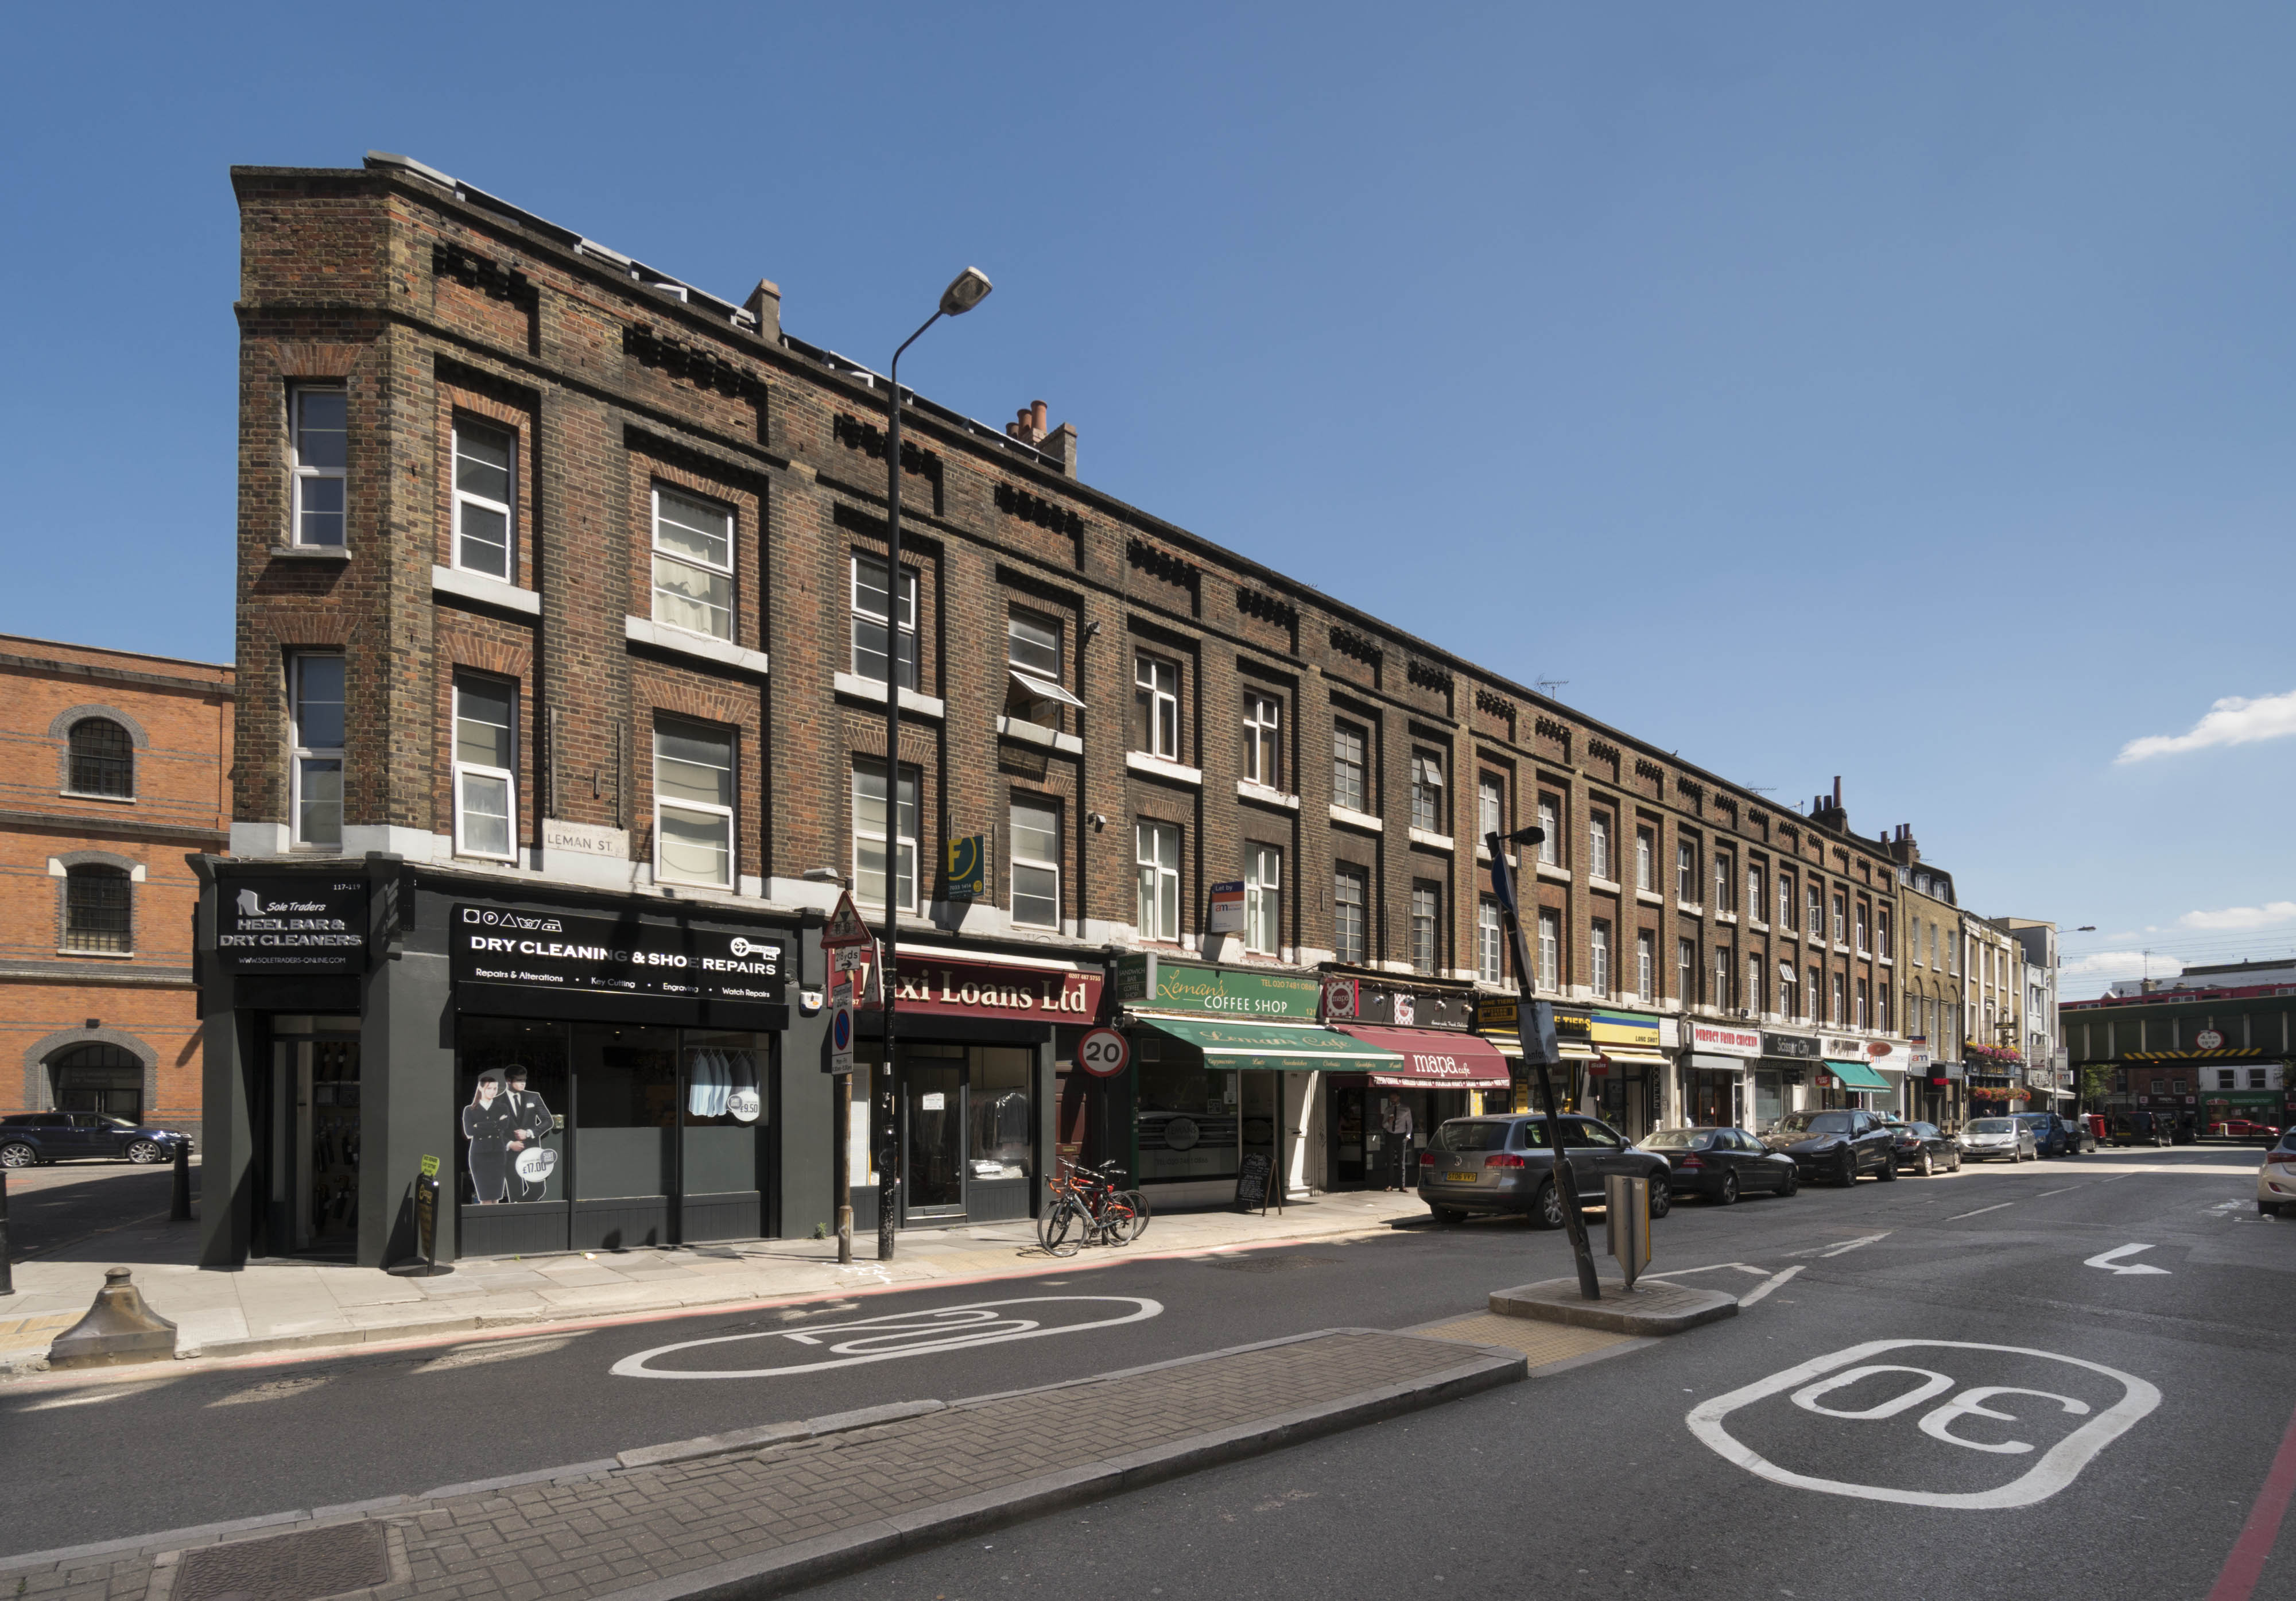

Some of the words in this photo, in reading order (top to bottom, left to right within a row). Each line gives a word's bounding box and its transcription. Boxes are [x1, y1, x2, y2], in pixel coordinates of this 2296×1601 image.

[548, 834, 592, 850] LEMAN
[266, 902, 288, 912] Sole
[289, 901, 327, 912] Traders
[237, 918, 288, 931] HEEL
[289, 919, 329, 931] BAR
[220, 935, 259, 946] DRY
[259, 934, 362, 946] CLEANERS
[471, 936, 517, 952] DRY
[519, 941, 628, 962] CLEANING
[632, 951, 645, 964] &
[648, 953, 699, 969] SHOE
[702, 958, 776, 975] REPAIRS
[476, 968, 509, 978] Repairs
[510, 970, 517, 978] &
[518, 971, 564, 982] Alterations
[1119, 968, 1146, 976] SANDWICH
[591, 976, 606, 986] Key
[607, 978, 635, 988] Cutting
[663, 982, 699, 993] Engraving
[1157, 970, 1228, 1000] Leman's
[1285, 981, 1300, 990] 7481
[1301, 982, 1316, 991] 0866
[722, 987, 744, 996] Watch
[745, 988, 770, 998] Repairs
[940, 970, 1033, 1009] Loans
[1040, 980, 1087, 1013] Ltd
[1204, 995, 1250, 1011] COFFEE
[1255, 999, 1287, 1013] SHOP
[1562, 1016, 1592, 1032] TIERS
[1695, 1028, 1719, 1044] PERFECT
[1720, 1032, 1735, 1045] FRIED
[1736, 1033, 1758, 1048] CHICKEN
[1086, 1041, 1120, 1063] 20
[1798, 1040, 1810, 1059] City
[1413, 1055, 1459, 1077] mapa
[1459, 1063, 1471, 1077] cafe
[740, 1103, 758, 1113] £9.50
[523, 1161, 546, 1174] £17.00
[1790, 1364, 2091, 1455] 30
